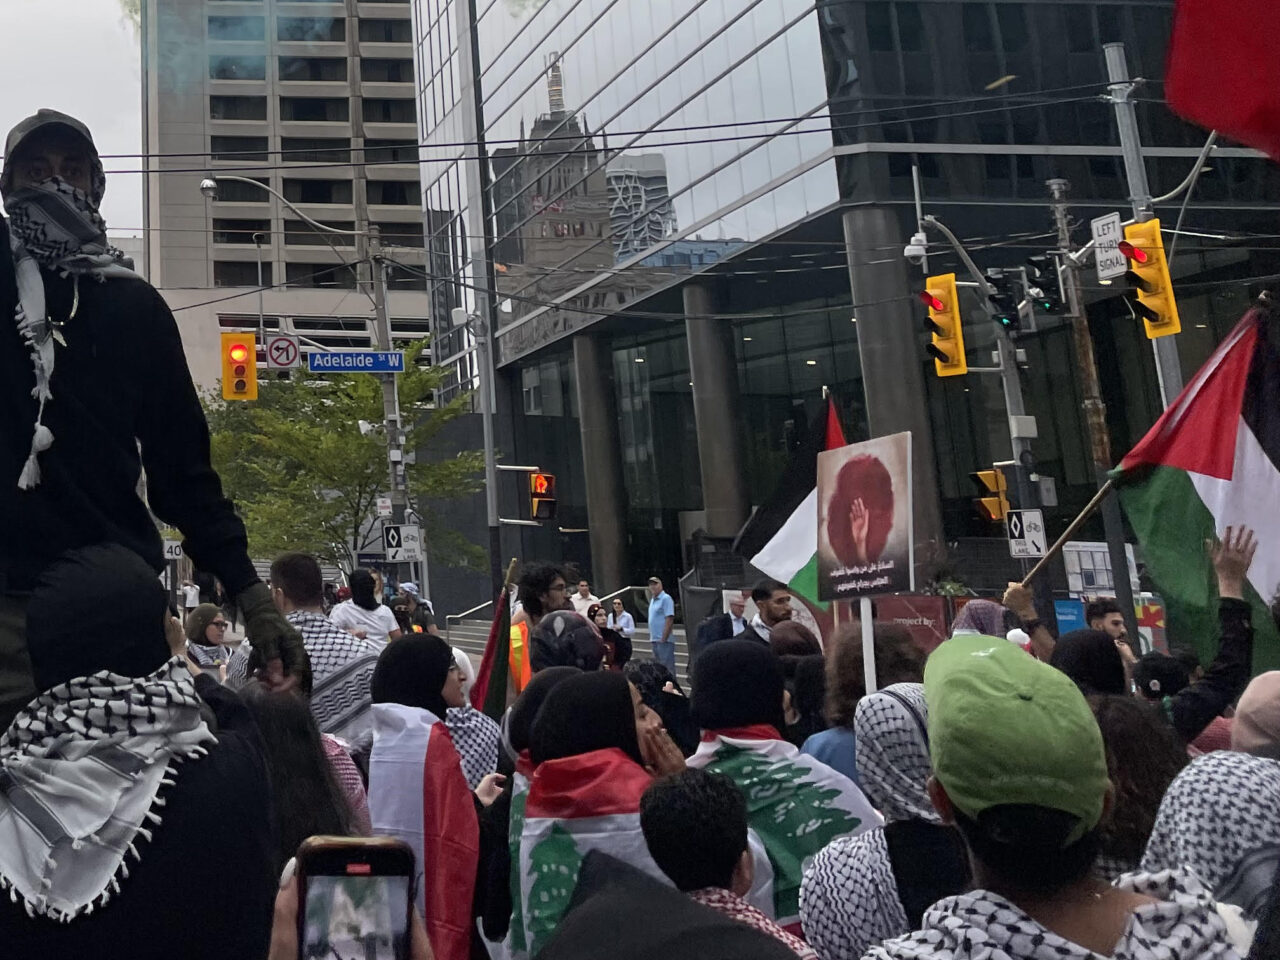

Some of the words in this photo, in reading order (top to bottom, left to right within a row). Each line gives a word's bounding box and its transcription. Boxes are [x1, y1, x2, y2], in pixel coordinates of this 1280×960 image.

[1097, 221, 1115, 237] LEFT
[1099, 238, 1120, 254] TURN
[1100, 255, 1124, 271] SIGNAL
[314, 354, 373, 367] Adelaide
[388, 354, 399, 367] W
[167, 545, 181, 556] 40
[893, 617, 922, 626] project
